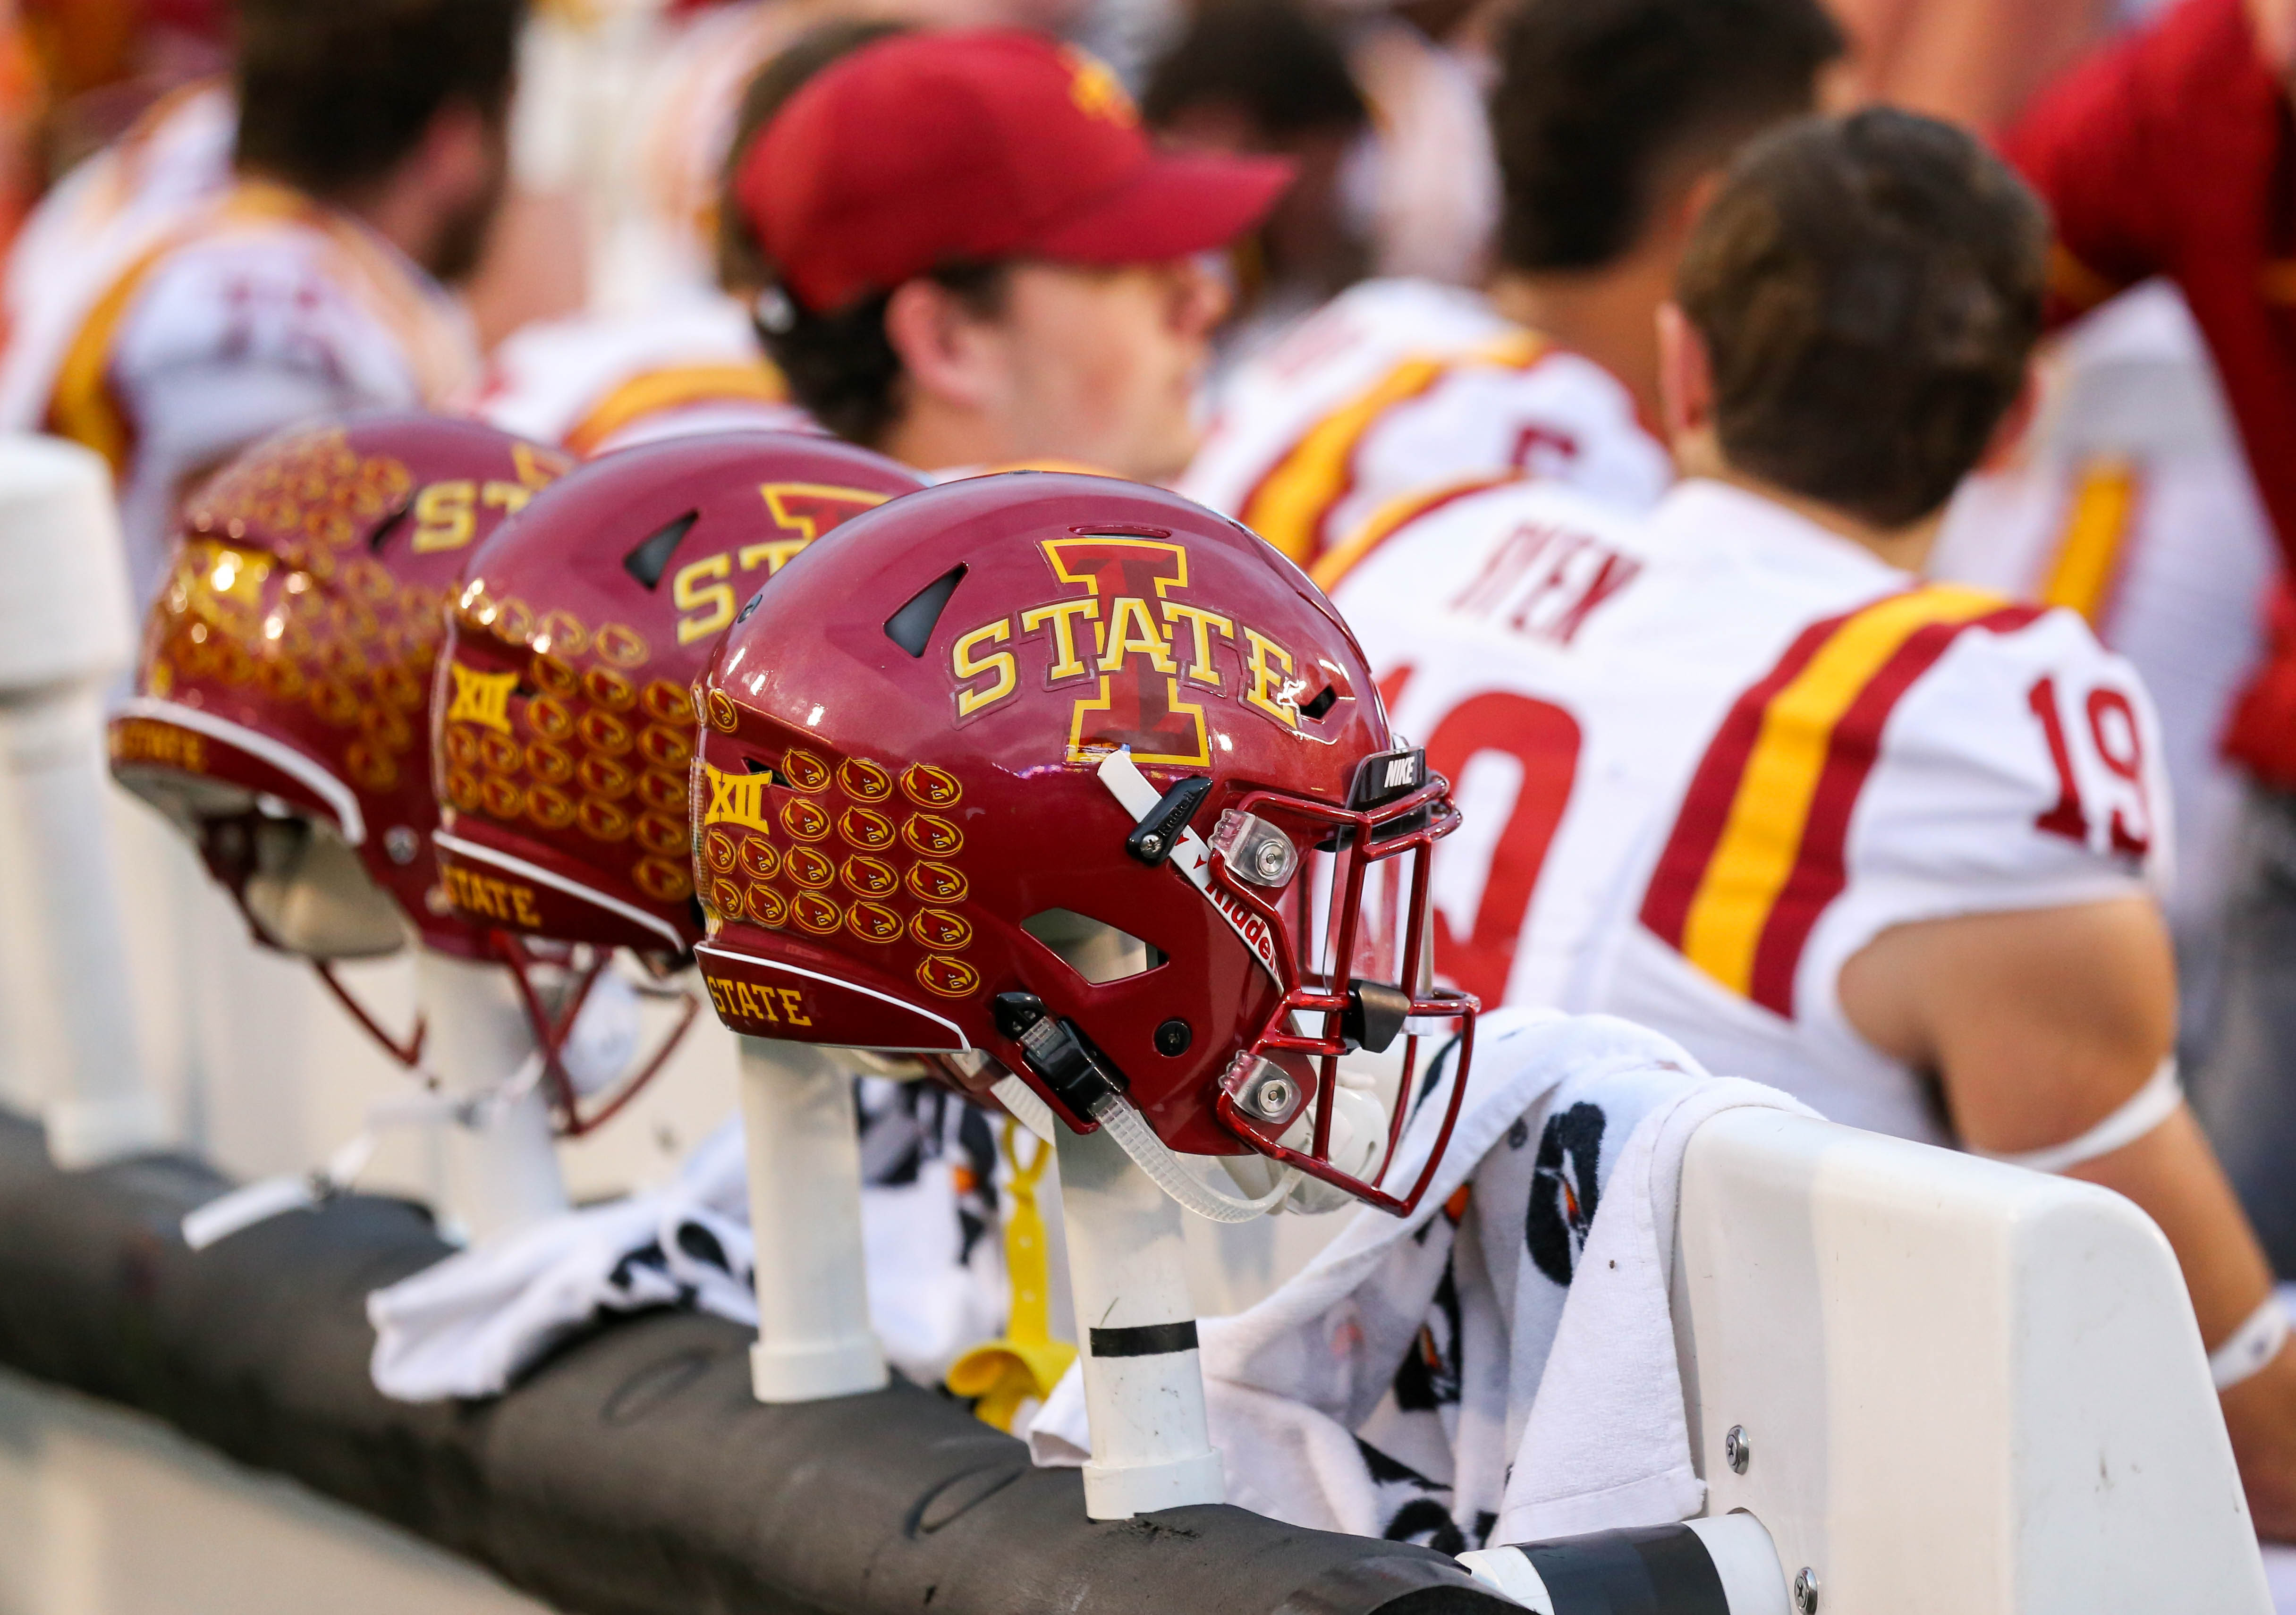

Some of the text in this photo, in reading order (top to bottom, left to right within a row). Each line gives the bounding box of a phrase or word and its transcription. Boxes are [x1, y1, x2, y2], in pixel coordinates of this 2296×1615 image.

[952, 597, 1298, 729] STATE
[704, 762, 772, 835] XII
[1384, 756, 1415, 788] NIKE
[2028, 676, 2148, 853] 19
[707, 975, 812, 1026] STATE
